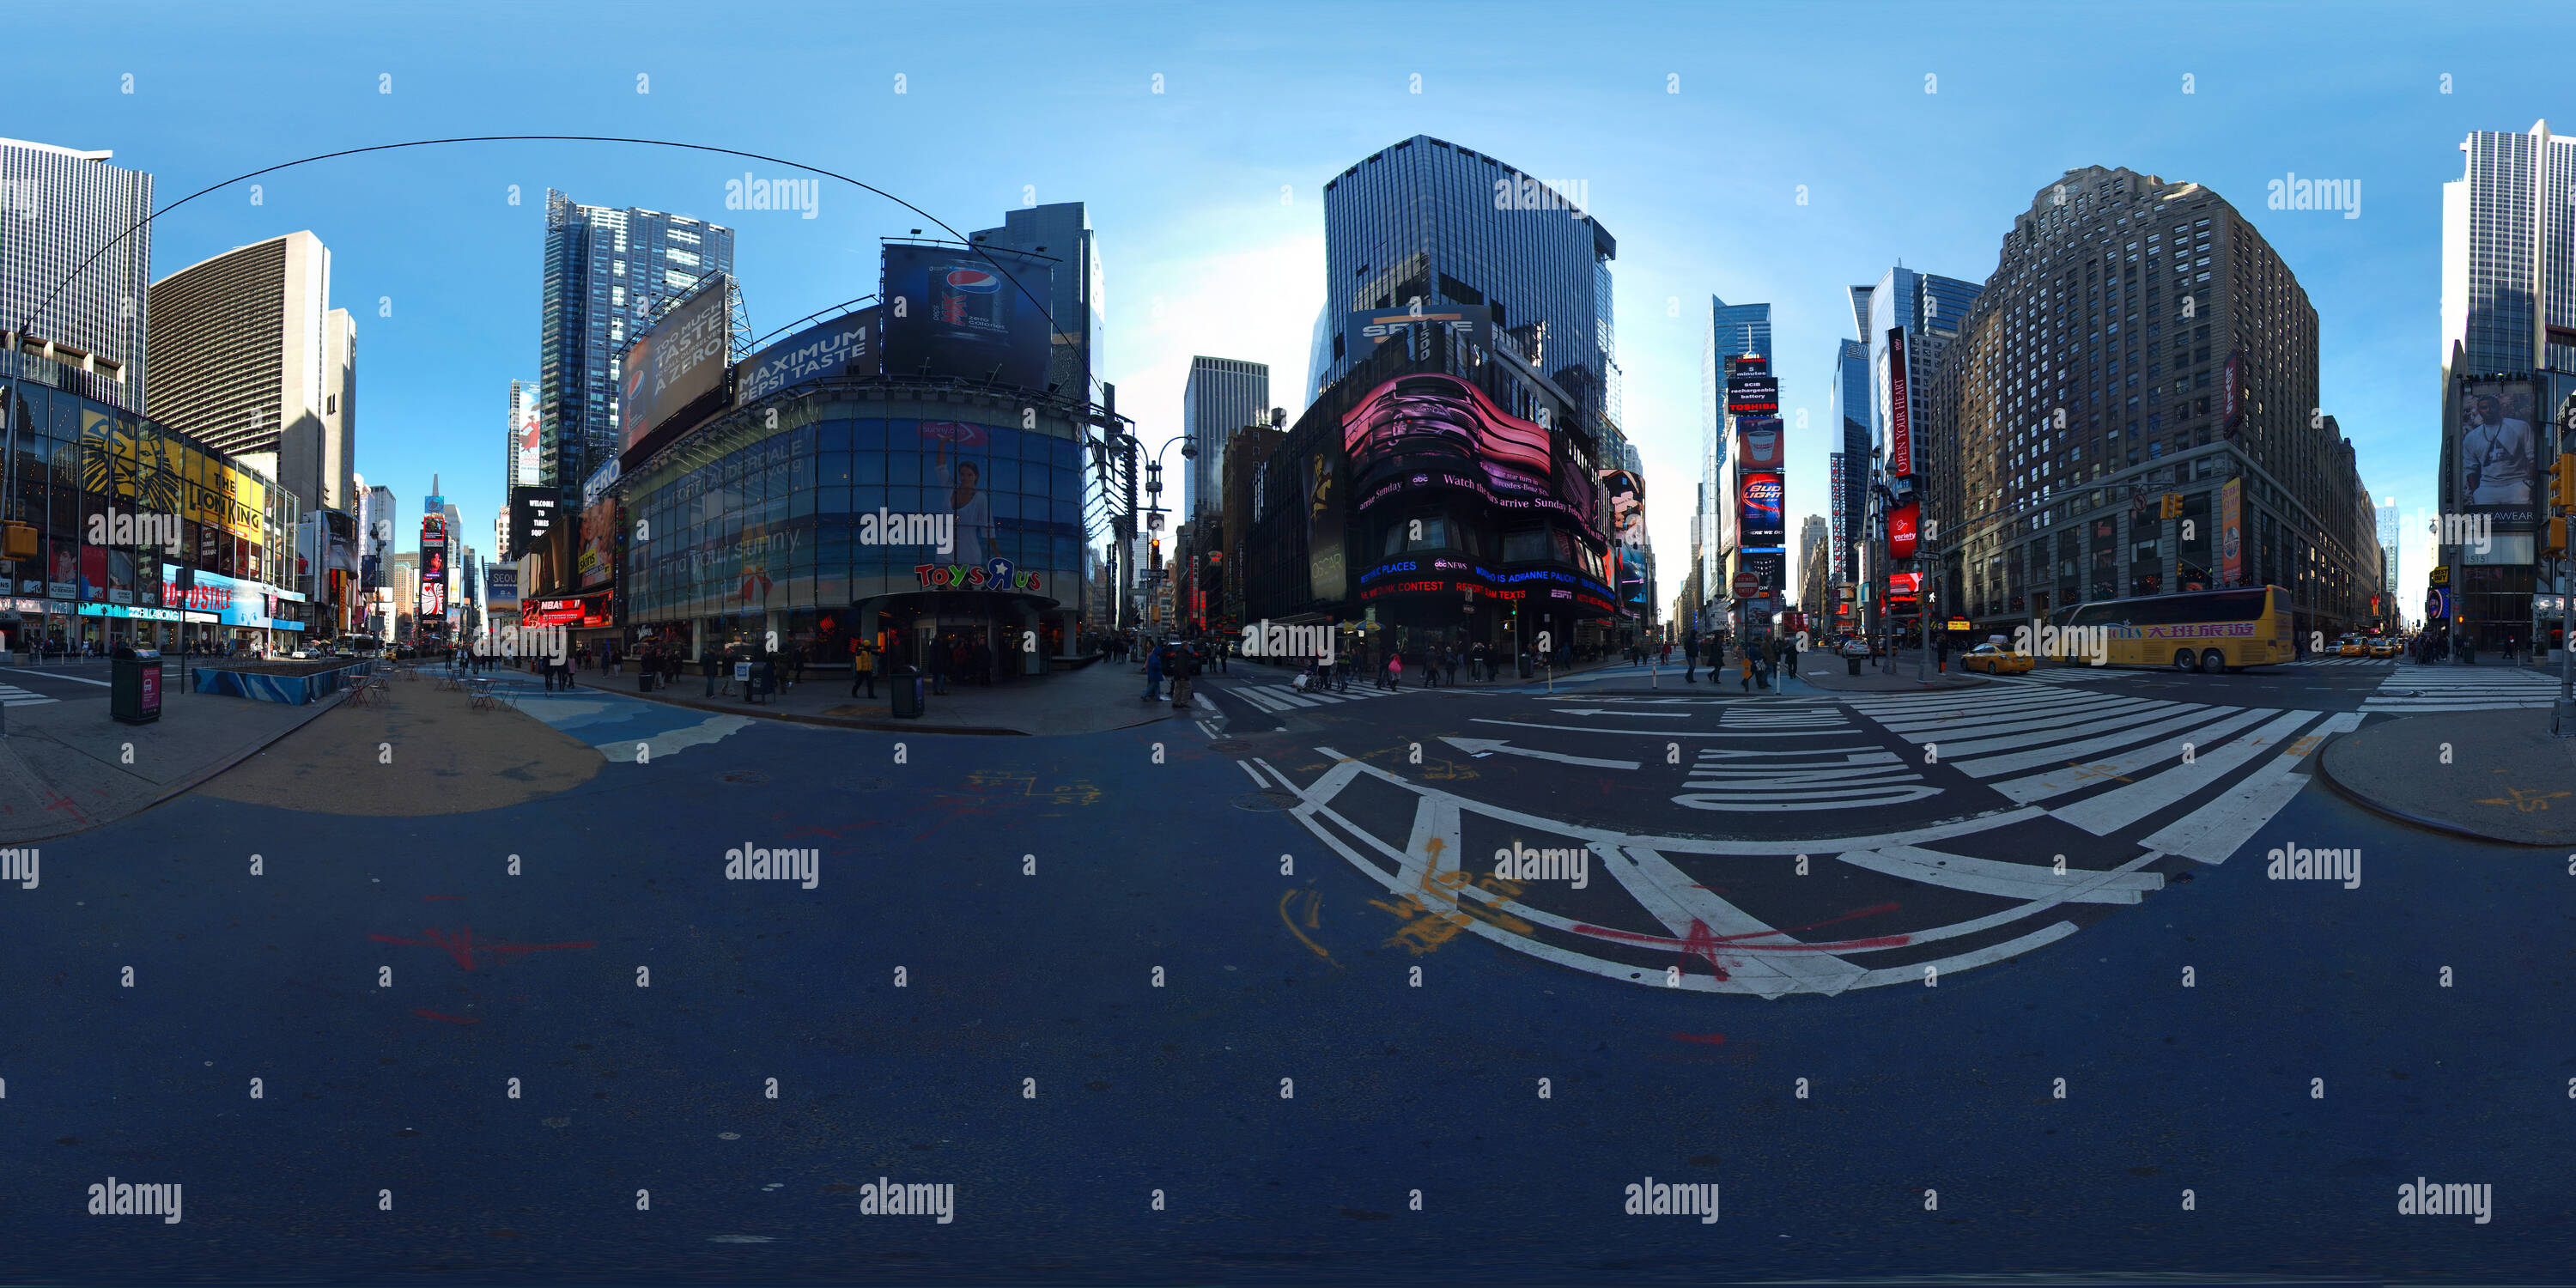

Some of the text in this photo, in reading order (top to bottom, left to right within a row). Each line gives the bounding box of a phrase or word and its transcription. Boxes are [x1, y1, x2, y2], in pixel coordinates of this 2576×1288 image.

[657, 301, 722, 355] TOO MUCH
[969, 314, 989, 323] zero
[655, 310, 723, 368] TASTE
[1362, 321, 1474, 337] SPE
[1419, 320, 1431, 363] 1500
[655, 337, 722, 398] A ZERO
[738, 325, 866, 392] MAXIMUM
[738, 343, 866, 406] PEPSI TASTE
[1893, 379, 1908, 472] OPEN YOUR HEART
[214, 473, 236, 494] THE
[584, 459, 621, 503] ZERO
[1412, 474, 1429, 485] abc
[1519, 475, 1532, 484] turn
[1376, 480, 1403, 500] Sunday
[1443, 473, 1475, 491] Watch
[1499, 499, 1529, 508] arrive
[1534, 498, 1567, 513] Sunday
[189, 478, 226, 515] LION
[228, 496, 259, 529] KING
[529, 500, 555, 508] WELCOME
[1894, 531, 1917, 541] variety
[580, 552, 595, 572] skins
[659, 556, 688, 577] Find
[1311, 552, 1343, 580] OSCAR
[1382, 561, 1418, 574] PLACES
[1435, 561, 1467, 570] abc NEWS
[1397, 580, 1444, 592] CONTEST
[1498, 574, 1505, 583] IS
[1498, 590, 1526, 599] TEXTS
[1551, 589, 1572, 600] ESPN
[140, 609, 179, 621] BILLABONG
[541, 600, 558, 611] NBA
